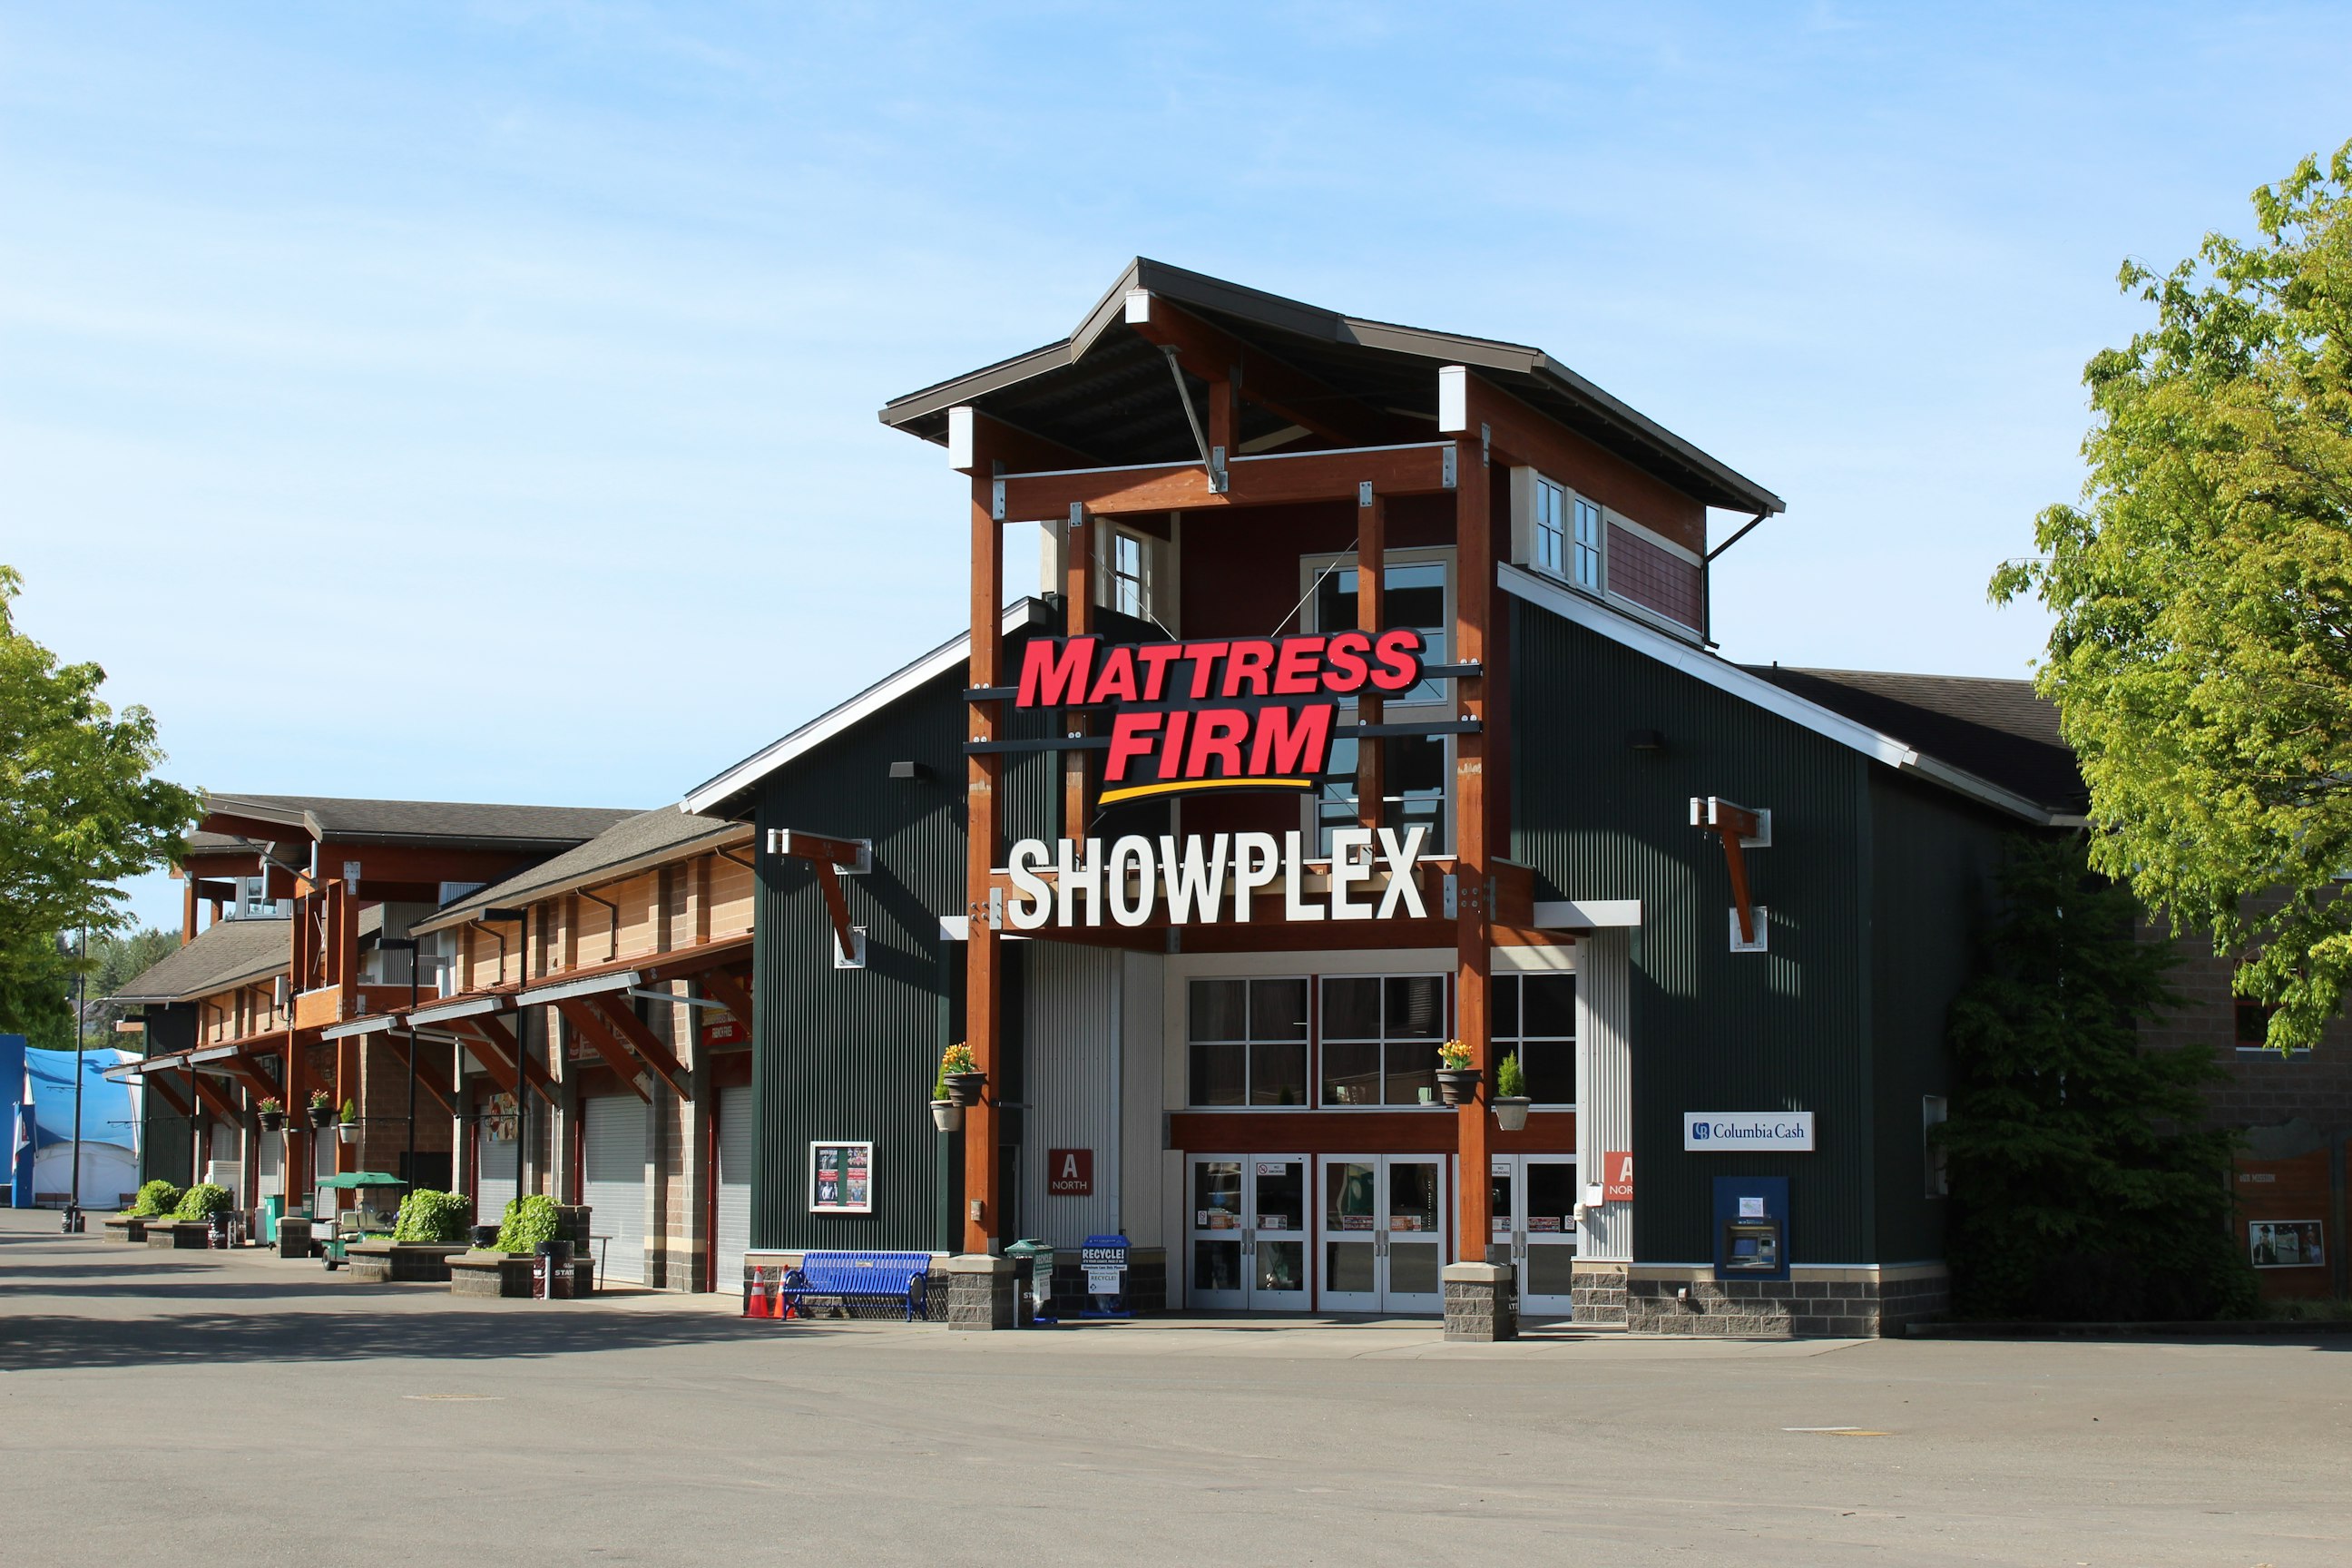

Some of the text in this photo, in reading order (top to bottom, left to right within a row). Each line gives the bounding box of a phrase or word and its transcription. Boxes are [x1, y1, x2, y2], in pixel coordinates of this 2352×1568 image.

[1015, 630, 1420, 708] MATTRESS
[1103, 703, 1334, 781] FIRM
[1007, 826, 1428, 930] SHOWPLEX
[1714, 1122, 1773, 1138] Columbia
[1775, 1122, 1805, 1138] Cash
[1062, 1153, 1078, 1178] A
[1619, 1156, 1632, 1182] A
[1053, 1181, 1087, 1190] NORTH
[1609, 1185, 1632, 1195] NOR
[1082, 1249, 1124, 1259] RECYCLE!
